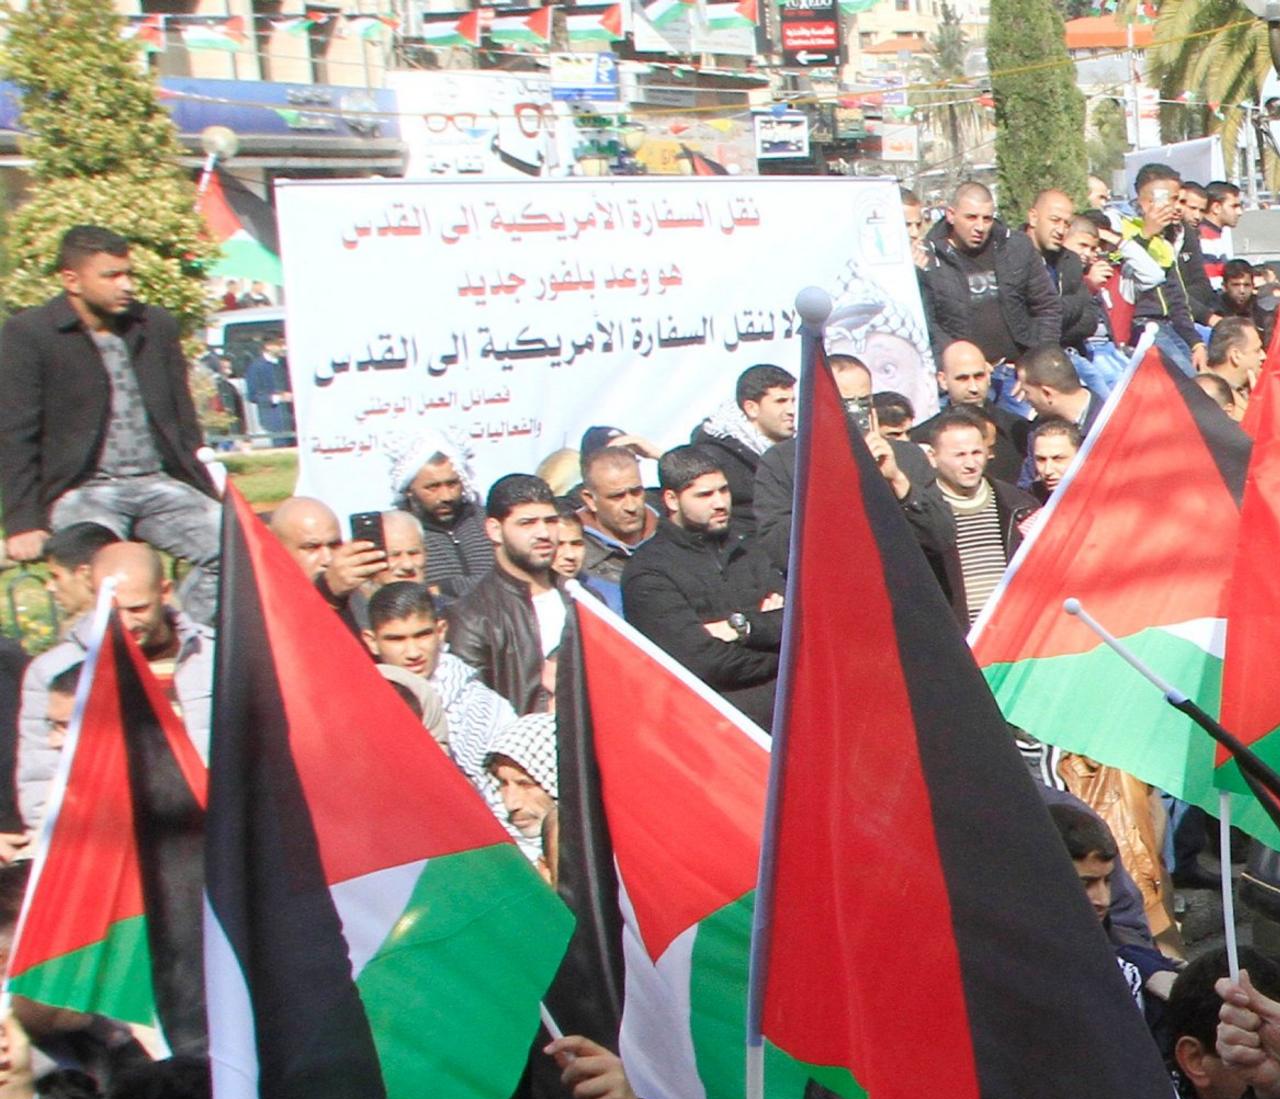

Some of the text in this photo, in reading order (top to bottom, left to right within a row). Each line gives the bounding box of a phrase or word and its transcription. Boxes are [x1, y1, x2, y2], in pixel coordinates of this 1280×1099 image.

[342, 203, 430, 250] القدس
[484, 192, 624, 241] الأمريكية
[632, 199, 712, 237] السفارة
[720, 198, 760, 236] نقل
[457, 260, 682, 306] هو وعد بلفور جديد
[478, 309, 624, 371] الأمريكية
[632, 314, 713, 357] السفارة
[724, 310, 774, 352] لنقل
[314, 334, 418, 387] القدس
[417, 392, 458, 416] العمل
